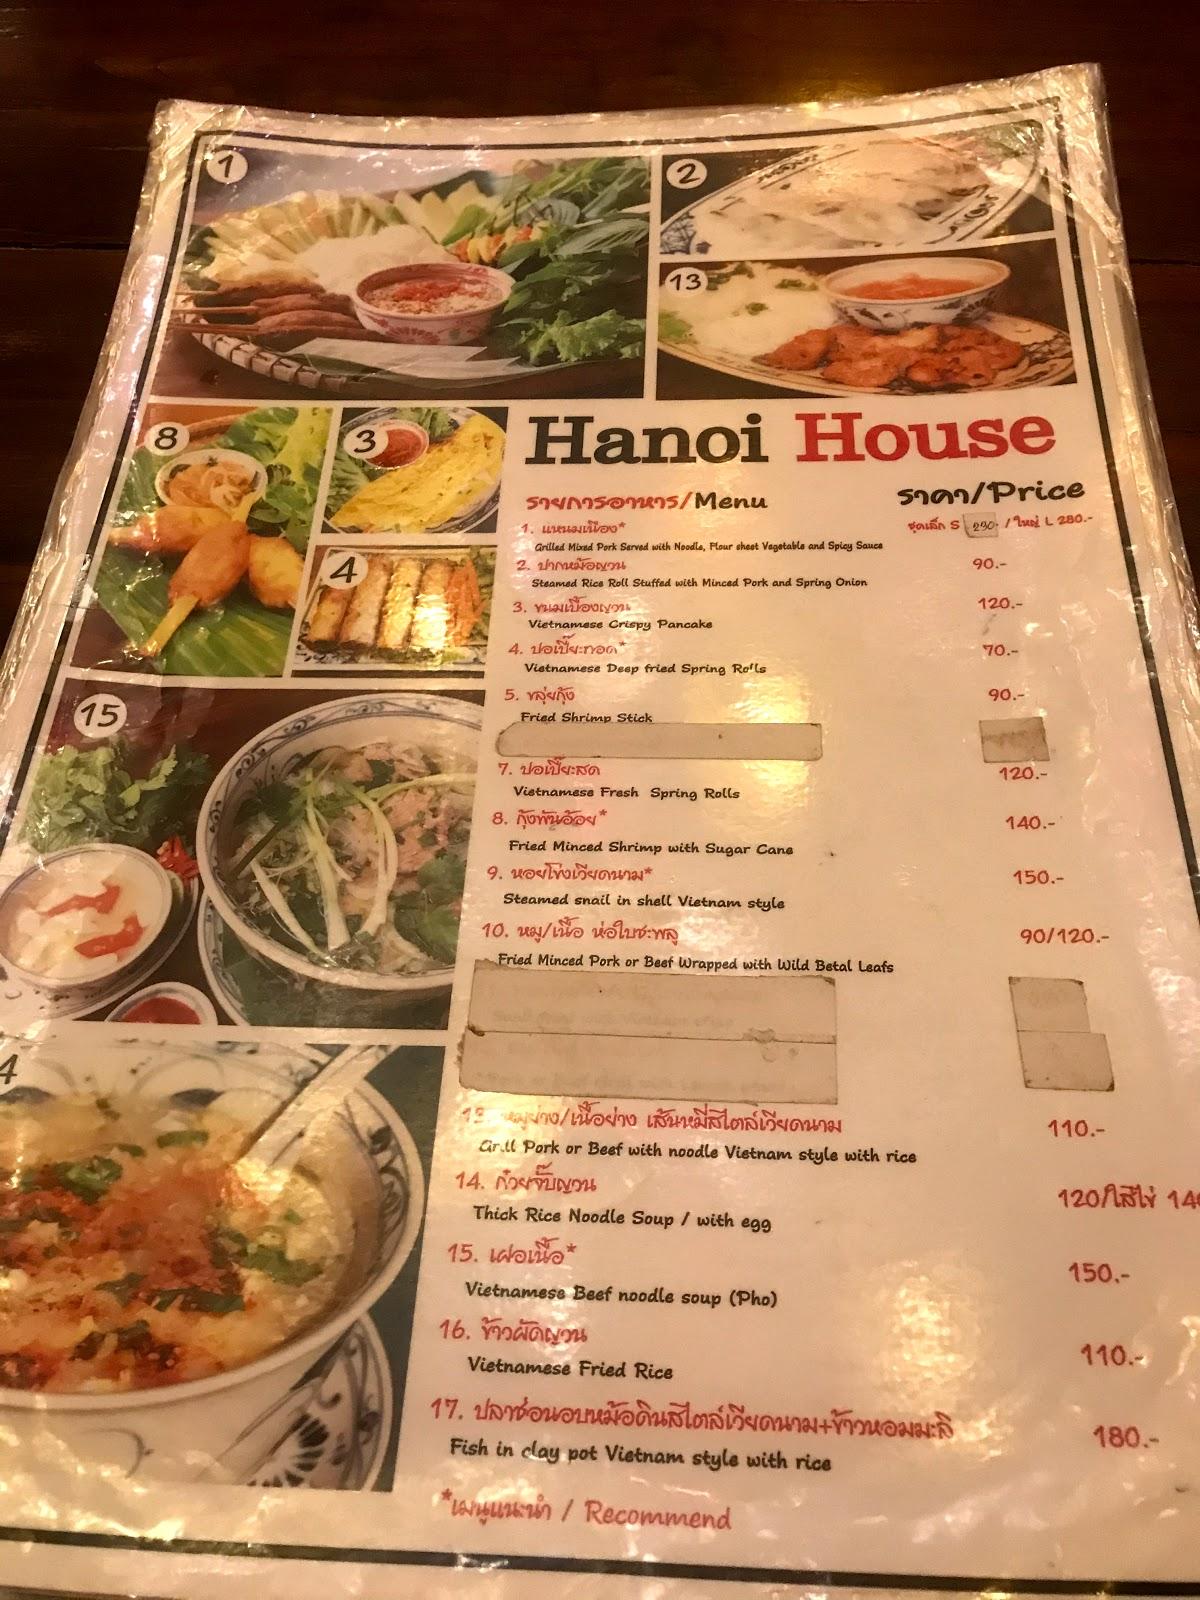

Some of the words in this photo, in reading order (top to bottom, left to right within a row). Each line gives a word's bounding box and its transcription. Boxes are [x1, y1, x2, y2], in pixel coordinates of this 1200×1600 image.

[218, 154, 235, 179] 1
[678, 162, 697, 185] 2
[669, 272, 702, 290] 13
[153, 426, 178, 451] 8
[353, 430, 377, 453] 3
[525, 412, 769, 465] Hanoi
[795, 412, 1057, 462] House
[897, 481, 1085, 505] ราคา/Price
[521, 523, 533, 534] 1.
[950, 520, 960, 530] S
[1005, 518, 1010, 528] /
[1045, 516, 1054, 526] L
[1057, 514, 1093, 525] 280.-
[535, 542, 565, 551] Grilled
[568, 543, 593, 551] Mixed
[597, 543, 617, 551] Pork
[620, 543, 648, 551] Served
[652, 542, 670, 551] with
[674, 542, 705, 551] Noodle,
[710, 542, 733, 550] Flour
[736, 541, 759, 550] sheet
[762, 541, 805, 553] Vegetable
[808, 541, 825, 550] and
[828, 541, 853, 552] Spicy
[856, 541, 883, 549] Sauce
[329, 556, 359, 582] 4
[516, 560, 530, 571] 2.
[973, 558, 1007, 570] 90.-
[532, 579, 577, 587] Steamed
[582, 579, 603, 587] Rice
[608, 578, 628, 587] Roll
[633, 578, 671, 587] Stuffed
[675, 578, 697, 587] with
[703, 578, 739, 587] Minced
[743, 578, 768, 587] Pork
[772, 578, 792, 587] and
[796, 578, 831, 589] Spring
[836, 577, 867, 586] Onion
[513, 602, 526, 613] 3.
[978, 597, 1023, 609] 120.-
[529, 620, 603, 629] Vietnamese
[609, 620, 651, 631] Crispy
[657, 619, 712, 628] Pancake
[508, 643, 523, 655] 4.
[983, 644, 1018, 656] 70.-
[524, 663, 600, 673] Vietnamese
[607, 663, 639, 675] Deep
[645, 664, 676, 673] fried
[682, 664, 726, 676] Spring
[505, 689, 518, 701] 5.
[988, 689, 1024, 701] 90.-
[78, 700, 120, 727] 15
[521, 712, 556, 724] Fried
[562, 712, 611, 723] Shrimp
[617, 713, 652, 723] Stick
[498, 763, 512, 775] 7.
[999, 767, 1047, 780] 120.-
[514, 786, 594, 797] Vietnamese
[600, 787, 639, 797] Fresh
[651, 788, 697, 801] Spring
[704, 788, 740, 799] Rolls
[492, 812, 507, 825] 8.
[1006, 816, 1055, 830] 140.-
[509, 840, 546, 851] Fried
[553, 841, 603, 852] Minced
[609, 841, 662, 855] Shrimp
[668, 842, 699, 853] with
[706, 843, 751, 857] Sugar
[756, 844, 793, 855] Cane
[487, 866, 502, 880] 9.
[1013, 870, 1064, 884] 150.-
[504, 893, 568, 905] Steamed
[575, 894, 610, 905] snail
[617, 895, 631, 905] in
[637, 894, 672, 906] shell
[678, 895, 741, 908] Vietnam
[748, 897, 785, 912] style
[482, 923, 508, 938] 10.
[1021, 928, 1109, 944] 90/120.-
[498, 953, 532, 967] Fried
[538, 954, 583, 966] Minced
[589, 955, 620, 966] Pork
[644, 955, 673, 968] Beef
[678, 957, 738, 974] Wrapped
[743, 958, 772, 969] with
[778, 958, 810, 971] Wild
[815, 960, 852, 972] Betal
[859, 961, 893, 973] Leafs
[1048, 1120, 1105, 1137] 110.-
[523, 1140, 559, 1154] Pork
[566, 1145, 582, 1154] or
[588, 1141, 623, 1156] Beef
[629, 1142, 662, 1156] with
[669, 1144, 718, 1158] noodle
[725, 1145, 792, 1160] Vietnam
[799, 1147, 838, 1165] style
[845, 1148, 880, 1162] with
[886, 1150, 917, 1163] rice
[456, 1171, 484, 1190] 14.
[473, 1205, 518, 1221] Thick
[525, 1207, 561, 1222] Rice
[569, 1208, 625, 1224] Noodle
[632, 1211, 674, 1229] Soup
[681, 1212, 690, 1226] /
[697, 1212, 734, 1227] with
[741, 1218, 771, 1233] egg
[448, 1243, 478, 1262] 15.
[1069, 1262, 1130, 1284] 150.-
[465, 1281, 565, 1300] Vietnamese
[573, 1285, 613, 1301] Beef
[619, 1287, 674, 1303] noodle
[681, 1290, 722, 1308] soup
[730, 1290, 777, 1308] (Pho)
[440, 1319, 470, 1340] 16.
[1081, 1344, 1143, 1366] 110.-
[468, 1356, 571, 1375] Vietnamese
[579, 1360, 626, 1377] Fried
[634, 1362, 673, 1379] Rice
[431, 1398, 463, 1420] 17.
[1093, 1425, 1159, 1448] 180.-
[451, 1438, 488, 1456] Fish
[496, 1441, 514, 1457] in
[521, 1440, 559, 1464] clay
[568, 1446, 597, 1463] pot
[605, 1445, 685, 1464] Vietnam
[692, 1448, 739, 1471] style
[747, 1450, 788, 1469] with
[796, 1454, 831, 1471] rice
[561, 1499, 574, 1522] /
[584, 1500, 732, 1530] Recommend
